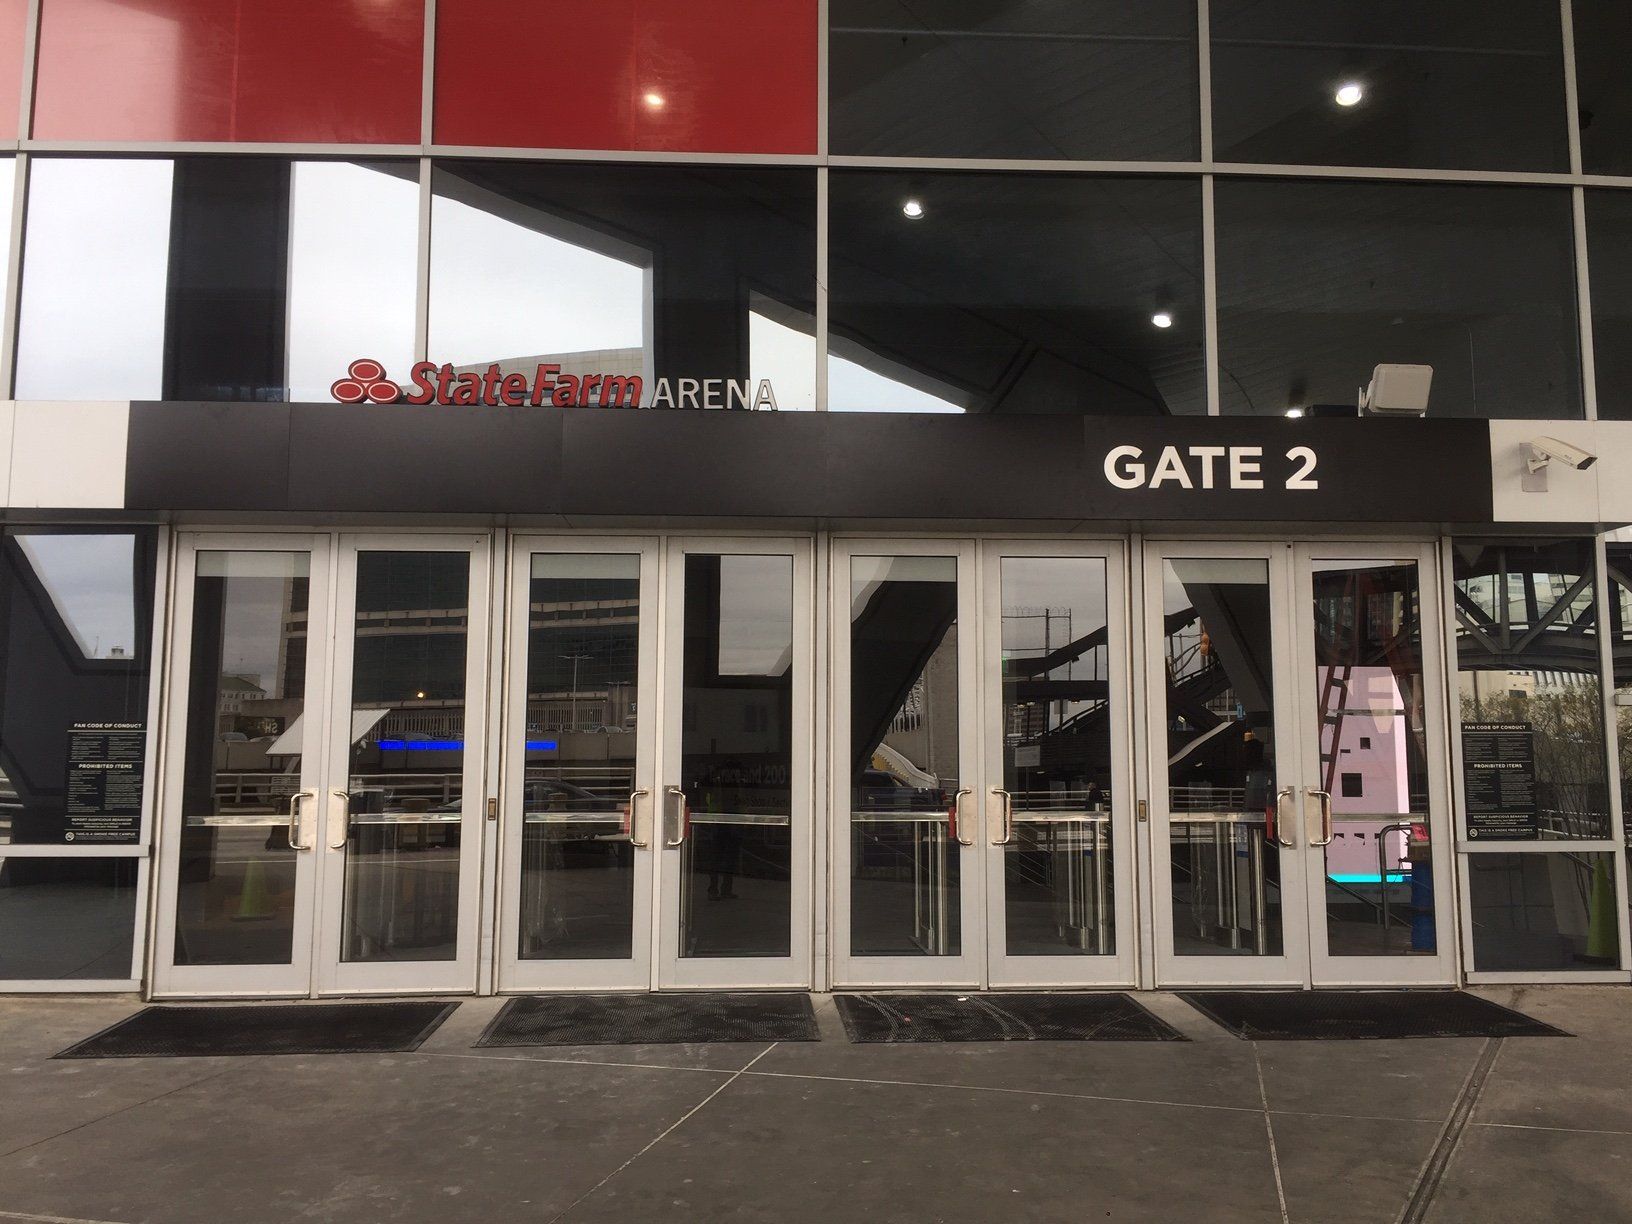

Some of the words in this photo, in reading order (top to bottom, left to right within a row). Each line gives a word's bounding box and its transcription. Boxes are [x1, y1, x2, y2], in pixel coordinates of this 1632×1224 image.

[407, 361, 527, 406] State
[530, 363, 643, 408] Farm
[651, 377, 778, 411] ARENA
[1103, 445, 1264, 489] GATE
[1285, 446, 1318, 489] 2
